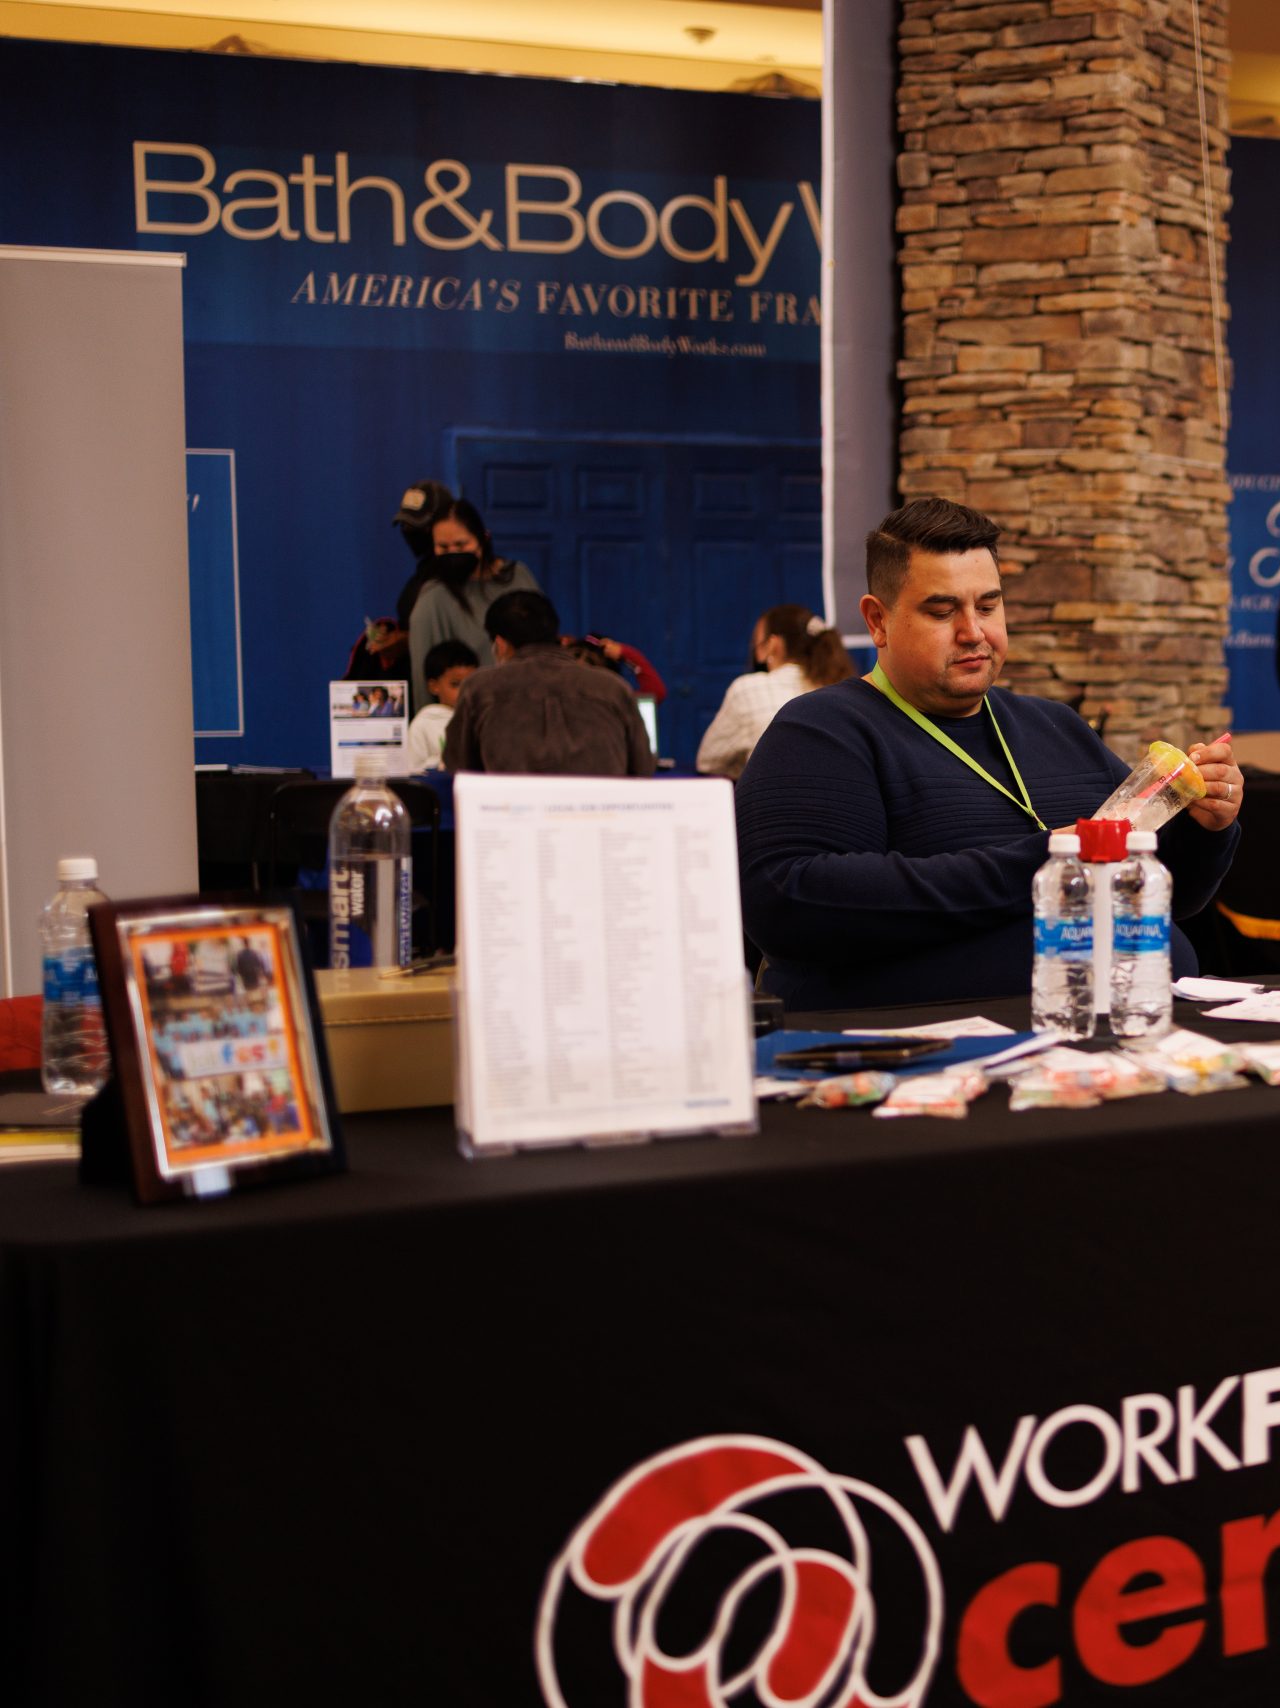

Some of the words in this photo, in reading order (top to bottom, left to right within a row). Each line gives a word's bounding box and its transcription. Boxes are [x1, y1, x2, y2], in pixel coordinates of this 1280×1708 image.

[292, 270, 520, 313] AMERICA'S
[536, 281, 736, 322] FAVORITE
[750, 291, 822, 327] FRA
[331, 866, 350, 970] smart
[351, 870, 364, 917] water
